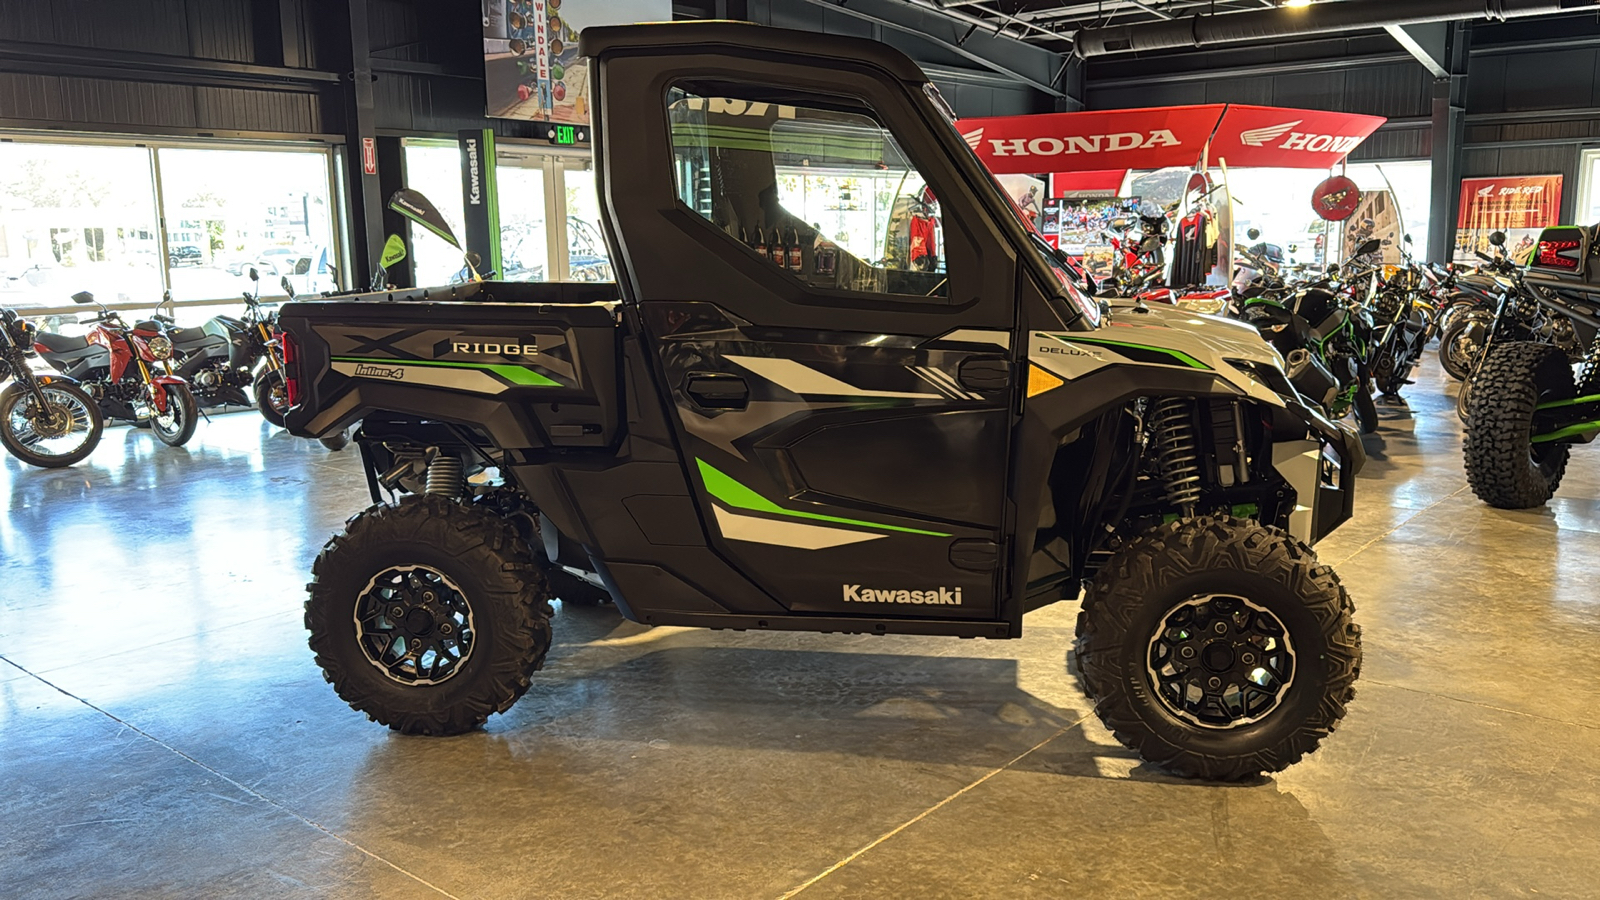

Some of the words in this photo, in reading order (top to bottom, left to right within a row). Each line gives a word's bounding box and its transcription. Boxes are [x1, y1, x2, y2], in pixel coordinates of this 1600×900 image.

[557, 126, 575, 144] EXIT
[987, 129, 1182, 156] HONDA
[466, 138, 481, 205] Kawasaki
[1498, 186, 1521, 196] RIDE
[1522, 186, 1543, 195] RED
[399, 197, 426, 216] Kawasaki
[453, 342, 539, 356] RIDGE
[1039, 346, 1103, 358] DELUXE
[354, 364, 404, 379] Inline-4
[842, 584, 962, 605] Kawasaki
